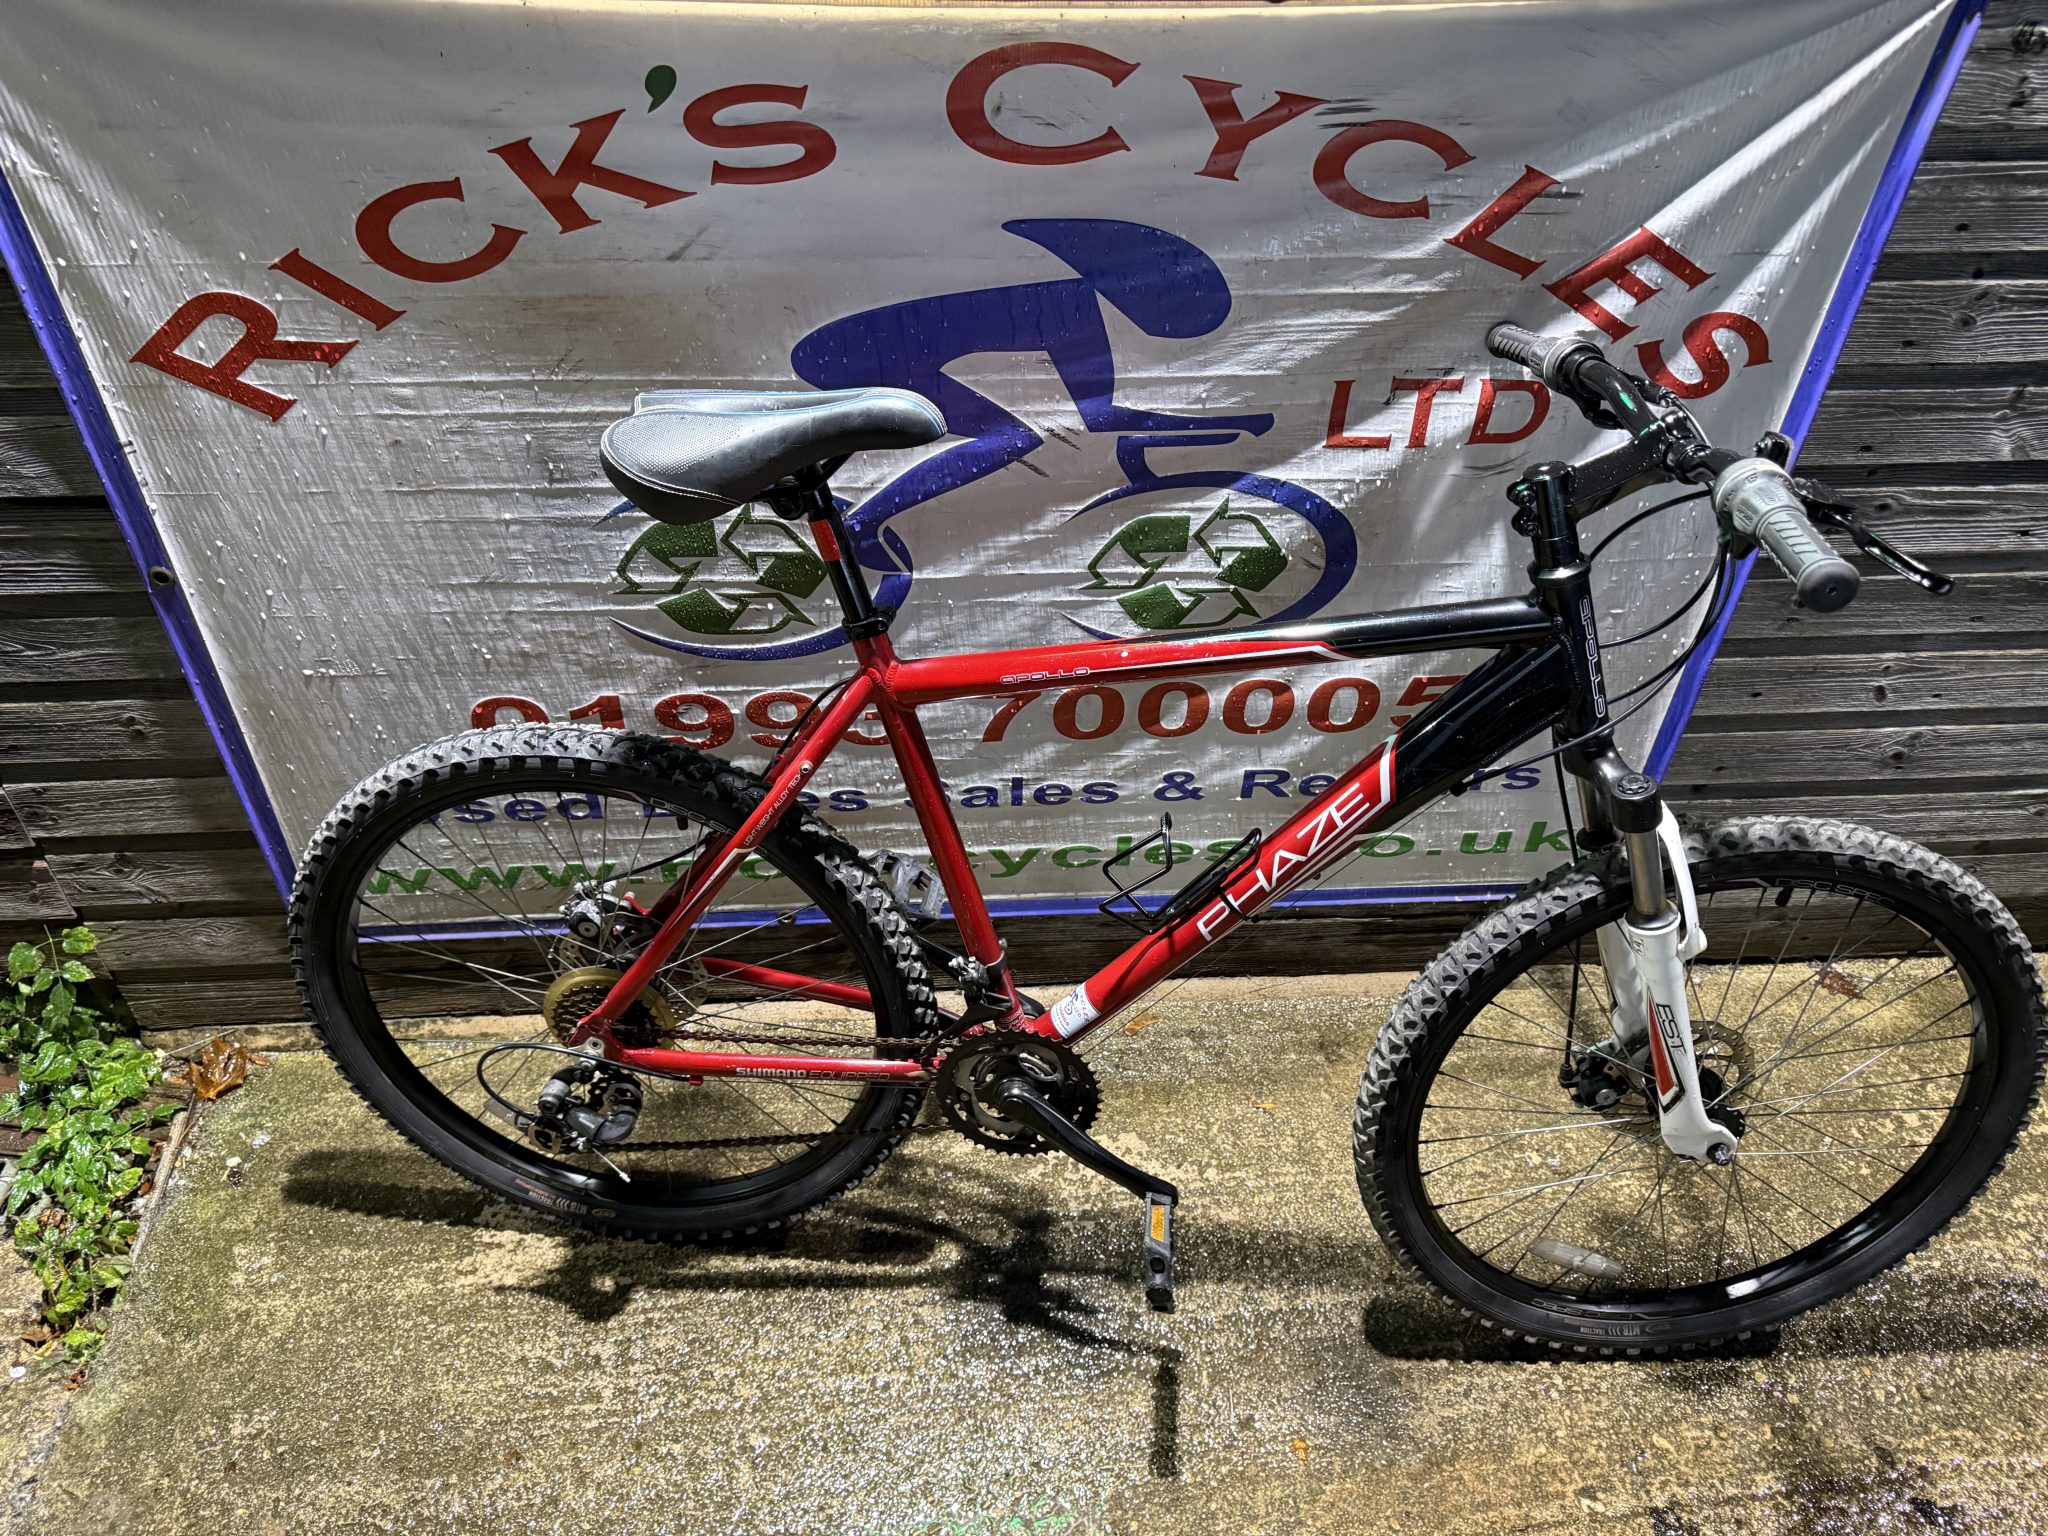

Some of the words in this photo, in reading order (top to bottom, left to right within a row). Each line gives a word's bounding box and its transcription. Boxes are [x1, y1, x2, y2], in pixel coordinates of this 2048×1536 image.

[131, 65, 837, 422] RICK'S
[946, 41, 1771, 399] CYCLES
[1322, 377, 1550, 449] LTD
[1000, 667, 1090, 685] APOLLO
[1580, 594, 1606, 718] APOLLO
[424, 792, 605, 825] sed
[905, 776, 1120, 808] ales
[1153, 769, 1205, 802] &
[1197, 782, 1370, 942] PHAZE
[735, 1067, 807, 1079] SHIMANO
[808, 1071, 891, 1082] EQUIPPED
